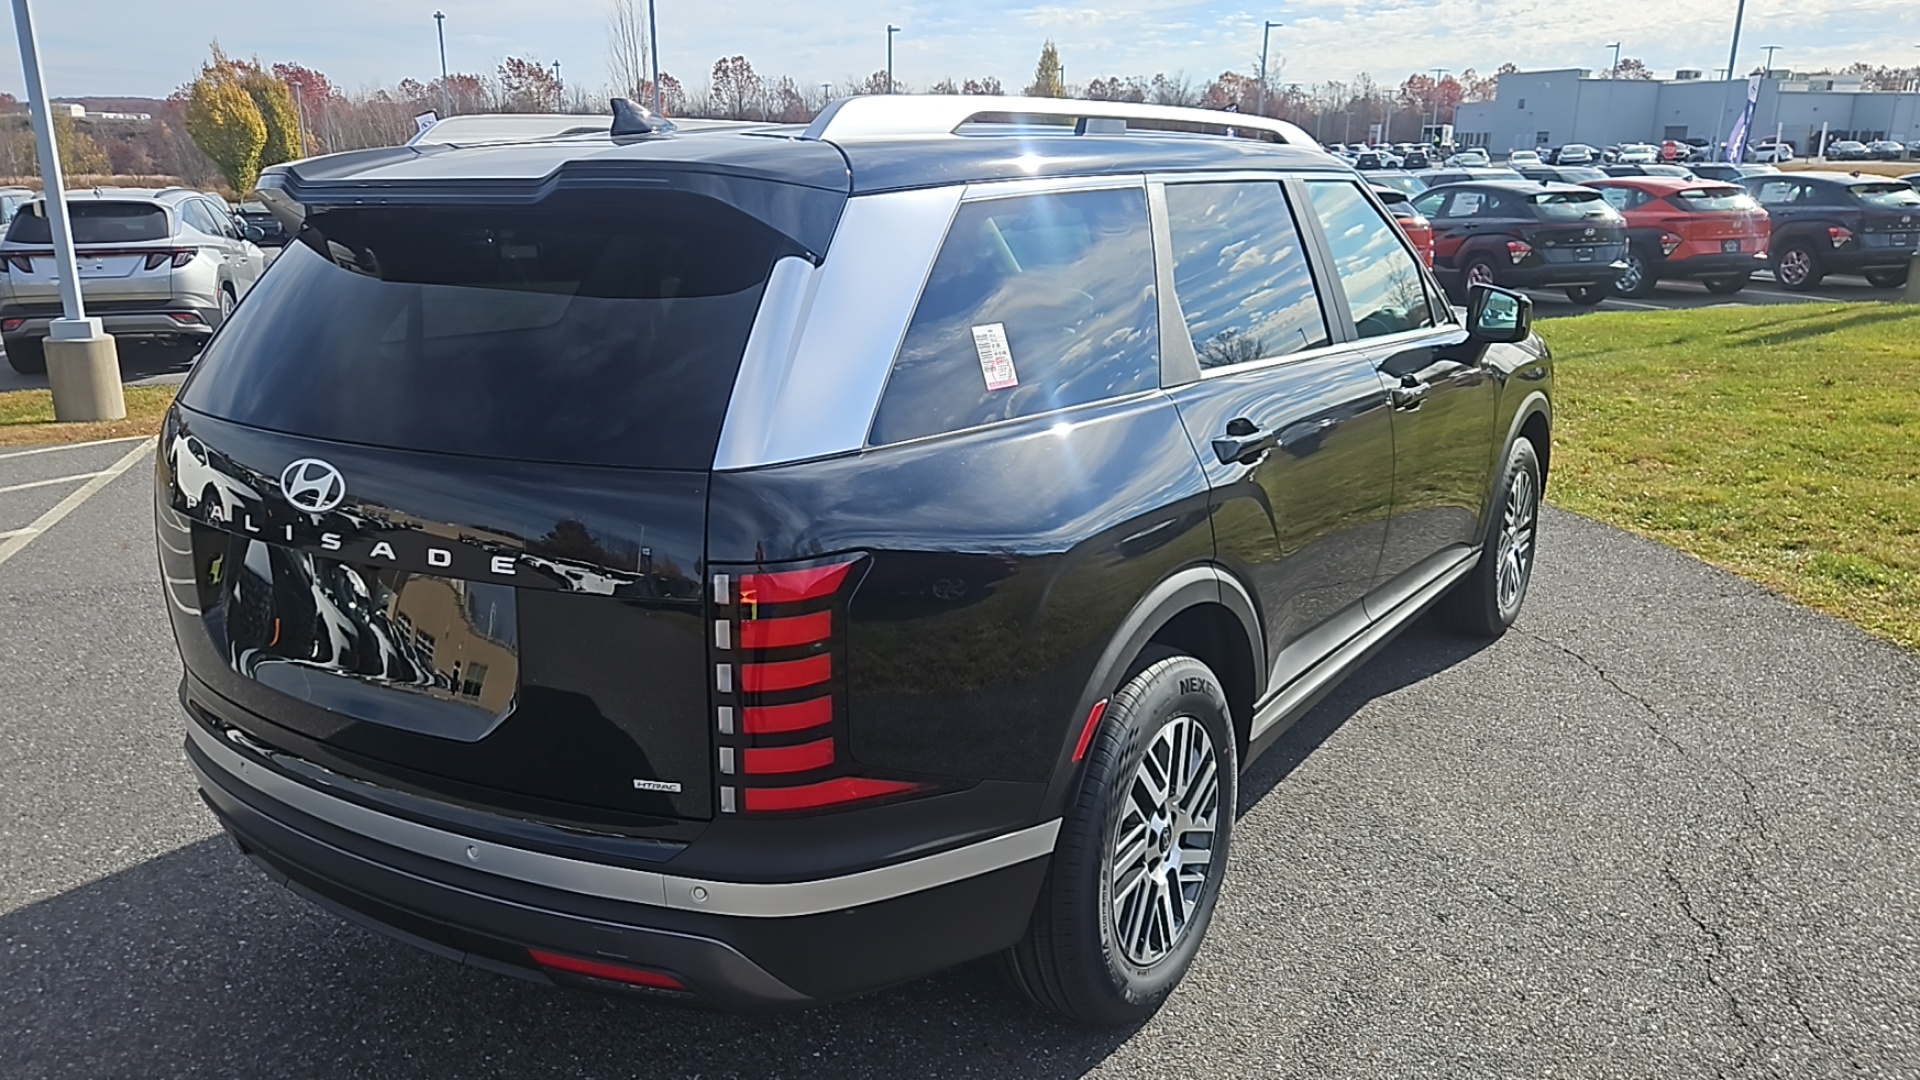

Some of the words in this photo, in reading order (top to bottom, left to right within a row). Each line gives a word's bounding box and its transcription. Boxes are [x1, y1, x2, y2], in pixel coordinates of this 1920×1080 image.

[186, 495, 517, 575] PALISADE
[1179, 677, 1219, 704] NEXE
[636, 781, 679, 791] HTRAC
